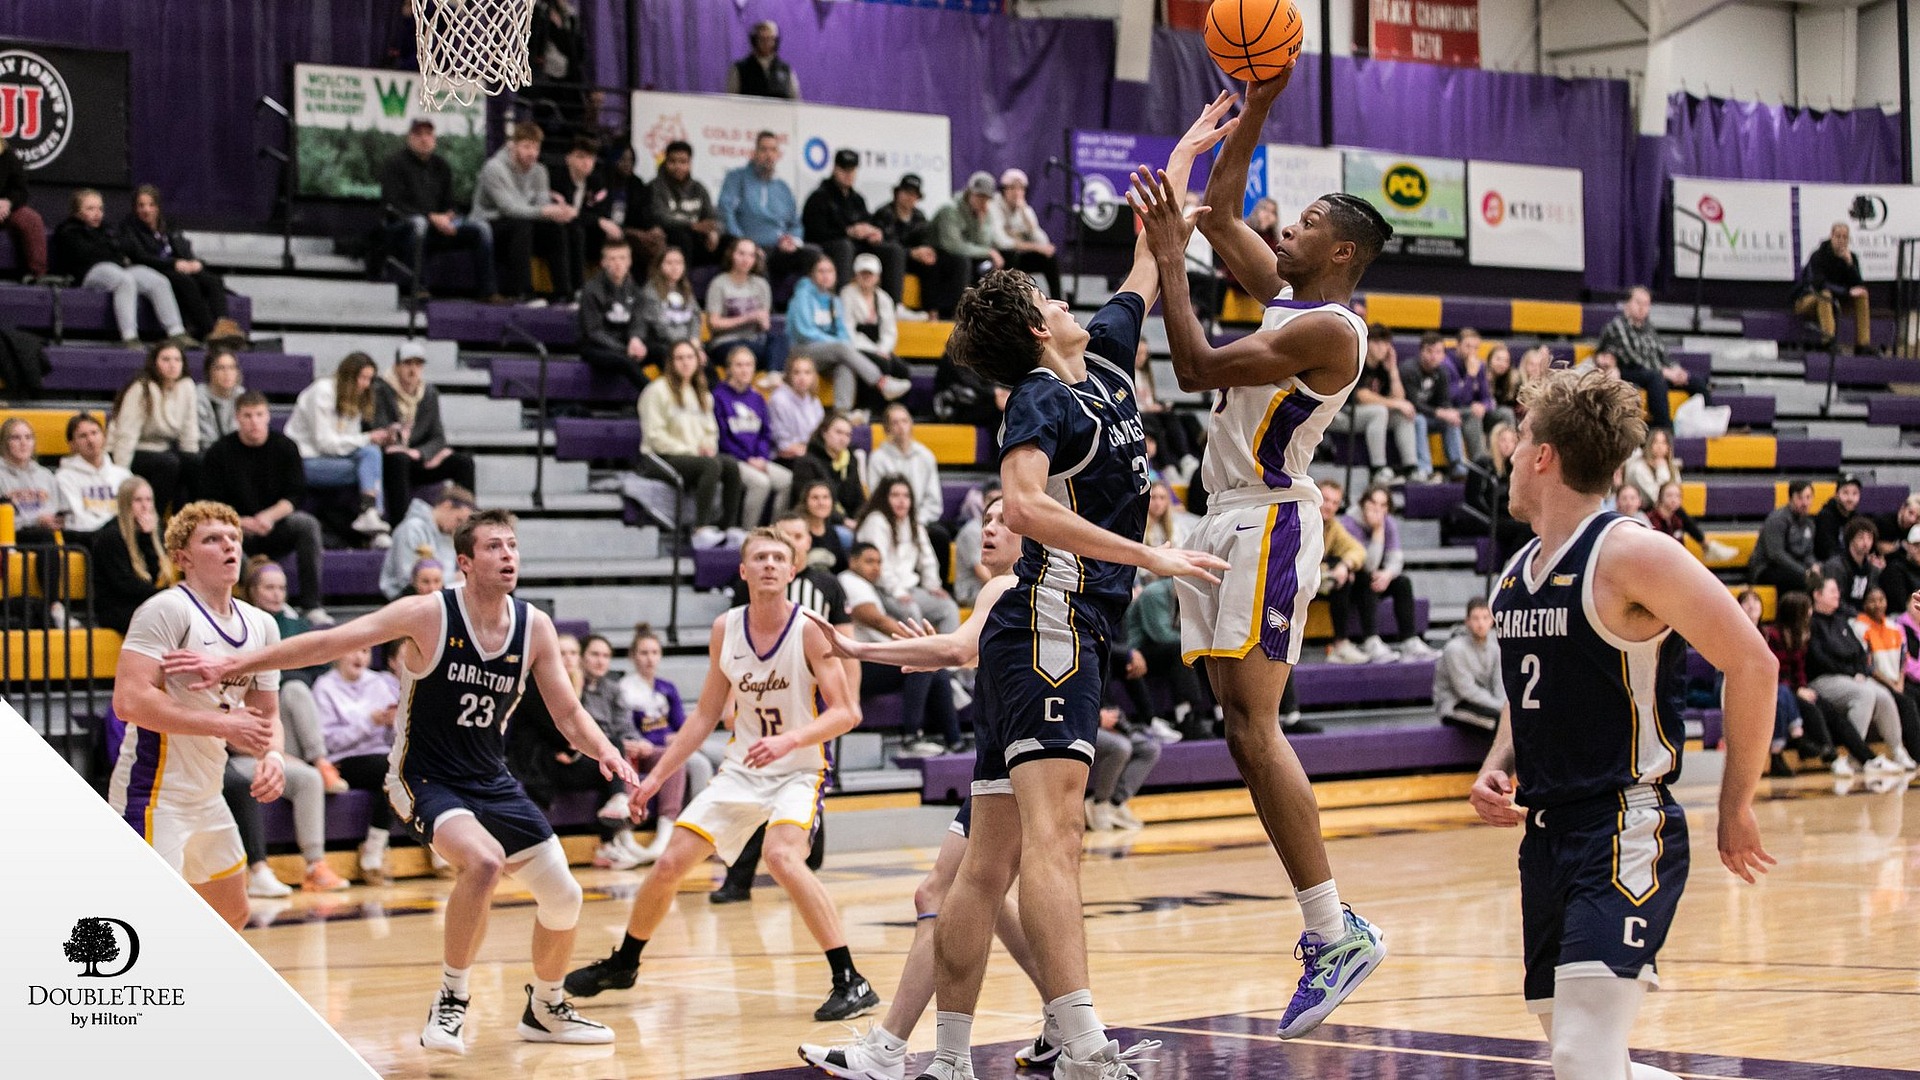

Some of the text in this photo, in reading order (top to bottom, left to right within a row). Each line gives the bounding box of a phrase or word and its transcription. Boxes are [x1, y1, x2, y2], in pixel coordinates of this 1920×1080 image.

[1495, 608, 1568, 639] CARLETON
[739, 670, 790, 701] Eagles
[1521, 654, 1540, 709] 2
[457, 693, 496, 727] 23
[755, 707, 782, 737] 12
[1044, 697, 1065, 721] C
[1623, 916, 1647, 948] C
